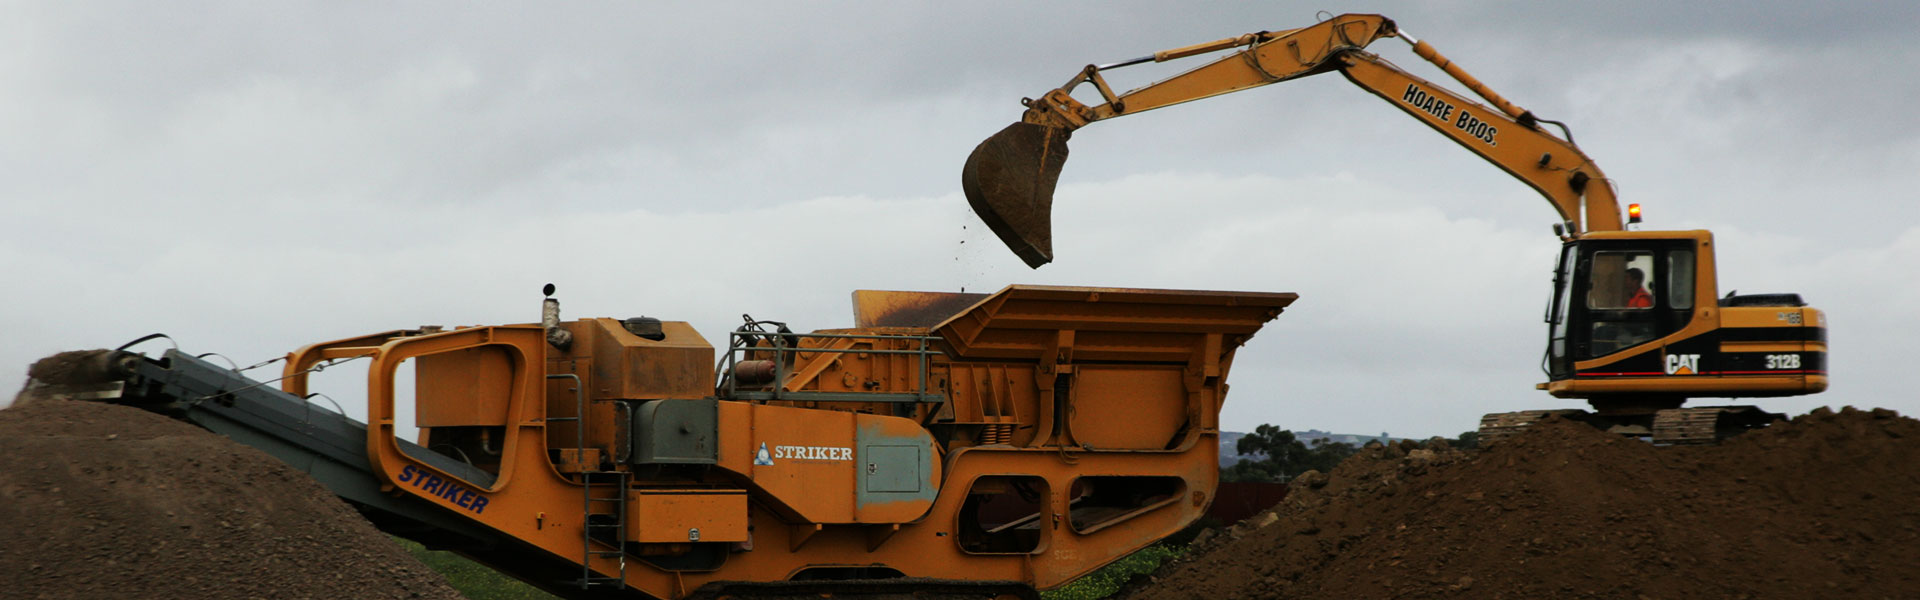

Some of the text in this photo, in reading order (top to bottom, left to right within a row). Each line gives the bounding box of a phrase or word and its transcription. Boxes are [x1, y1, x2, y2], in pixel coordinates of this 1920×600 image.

[1402, 83, 1497, 148] HOARE BROS.
[1665, 354, 1700, 375] CAT
[1764, 354, 1801, 369] 312B
[775, 445, 853, 461] STRIKER
[398, 464, 489, 515] STRIKER
